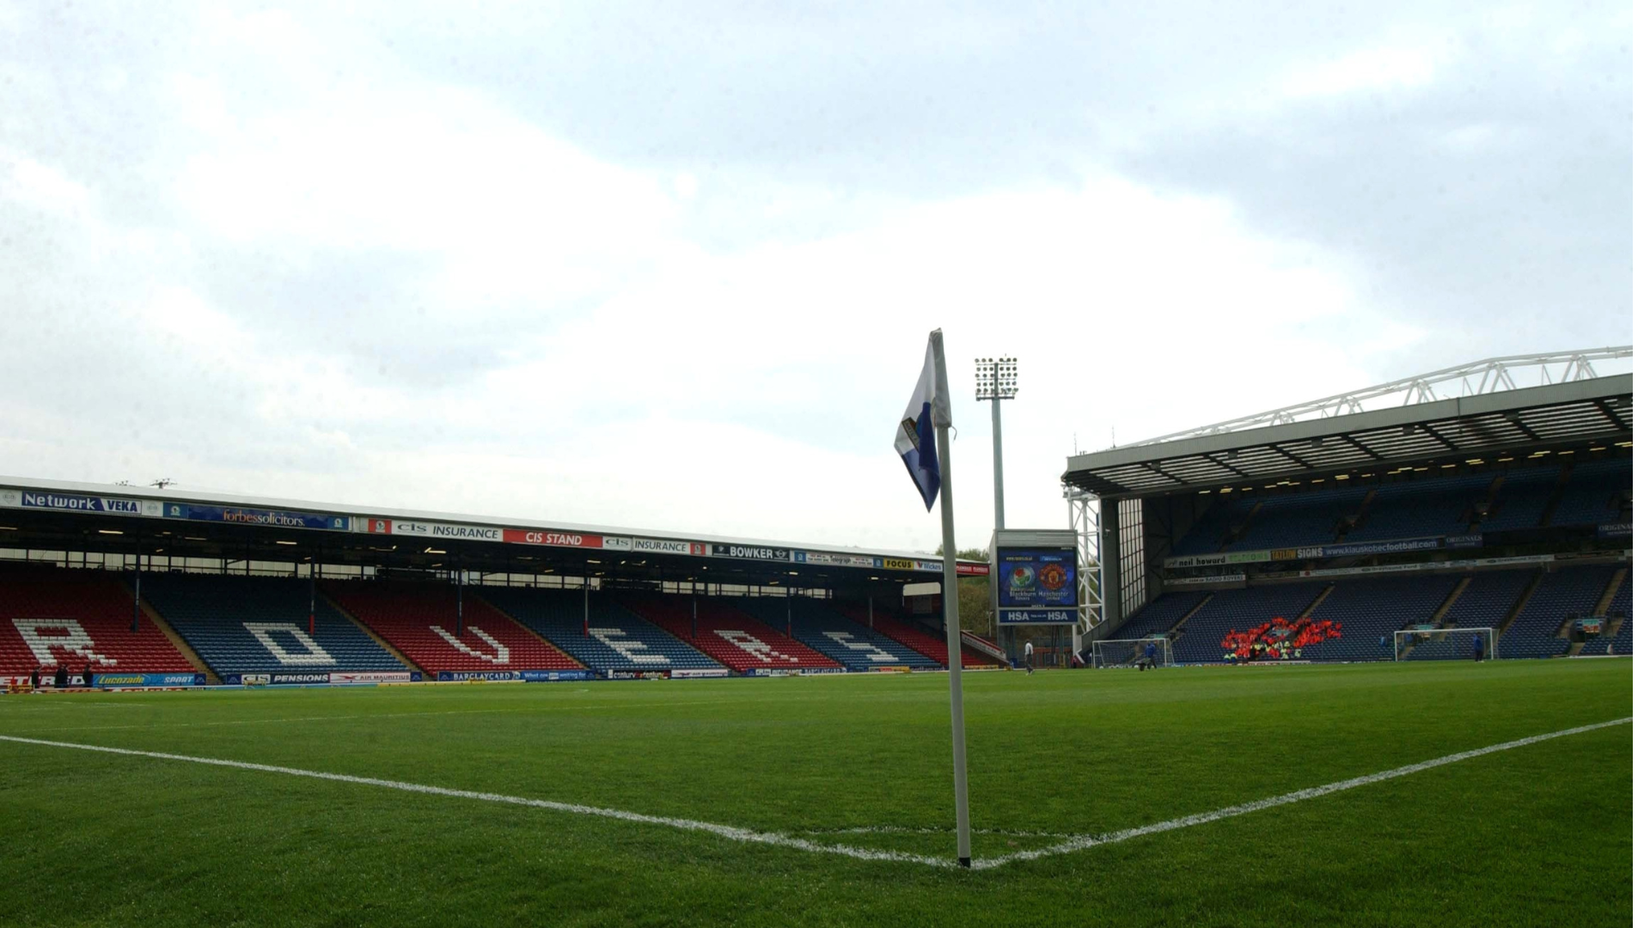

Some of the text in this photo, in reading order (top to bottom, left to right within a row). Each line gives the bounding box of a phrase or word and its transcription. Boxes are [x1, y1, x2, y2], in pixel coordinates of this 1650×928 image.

[25, 493, 96, 510] Network
[107, 500, 138, 512] VEKA
[432, 525, 498, 539] INSURANCE
[1599, 523, 1633, 531] ORIGINA
[525, 532, 583, 546] CIS STAND
[1446, 535, 1482, 543] ORIGINALS
[634, 540, 686, 552] INSURANCE
[729, 546, 773, 559] BOWKER
[1297, 547, 1323, 559] SIGNS
[886, 560, 912, 569] FOCUS
[1179, 556, 1226, 567] neil howard
[1008, 612, 1029, 620] HSA
[1047, 611, 1068, 620] HSA
[98, 674, 194, 684] Lucozade SPORT
[274, 674, 329, 682] PENSIONS
[453, 672, 511, 680] BARCLAYCARD
